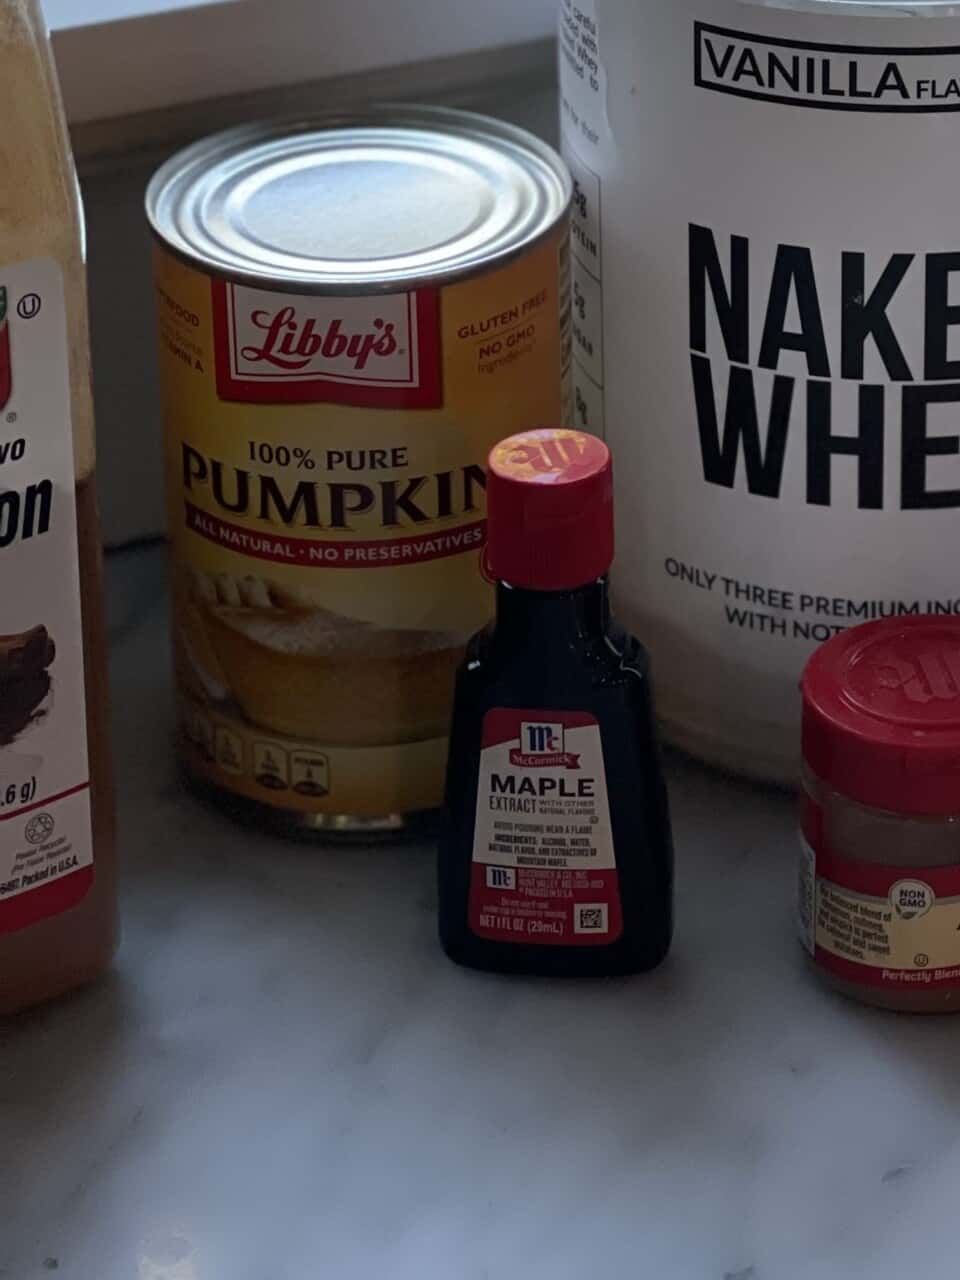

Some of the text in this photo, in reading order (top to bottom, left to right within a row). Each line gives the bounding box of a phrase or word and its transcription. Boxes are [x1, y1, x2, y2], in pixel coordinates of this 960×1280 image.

[703, 36, 911, 99] VANILLA
[240, 305, 398, 370] Libby's
[457, 304, 520, 340] GLUTEN
[478, 323, 537, 360] NO GMO
[247, 440, 410, 472] 100% PURE
[180, 440, 489, 530] PUMPKIN
[192, 512, 483, 562] ALL NATURAL NO PRESERVATIVES
[664, 557, 718, 591] ONLY
[720, 576, 794, 612] THREE
[799, 594, 920, 619] PREMIUM
[724, 605, 788, 635] WITH
[19, 775, 38, 804] g)
[490, 773, 596, 798] MAPLE
[488, 795, 537, 815] EXTRACT
[898, 898, 927, 909] GMO
[899, 888, 926, 899] NON
[881, 968, 932, 983] Perfectly
